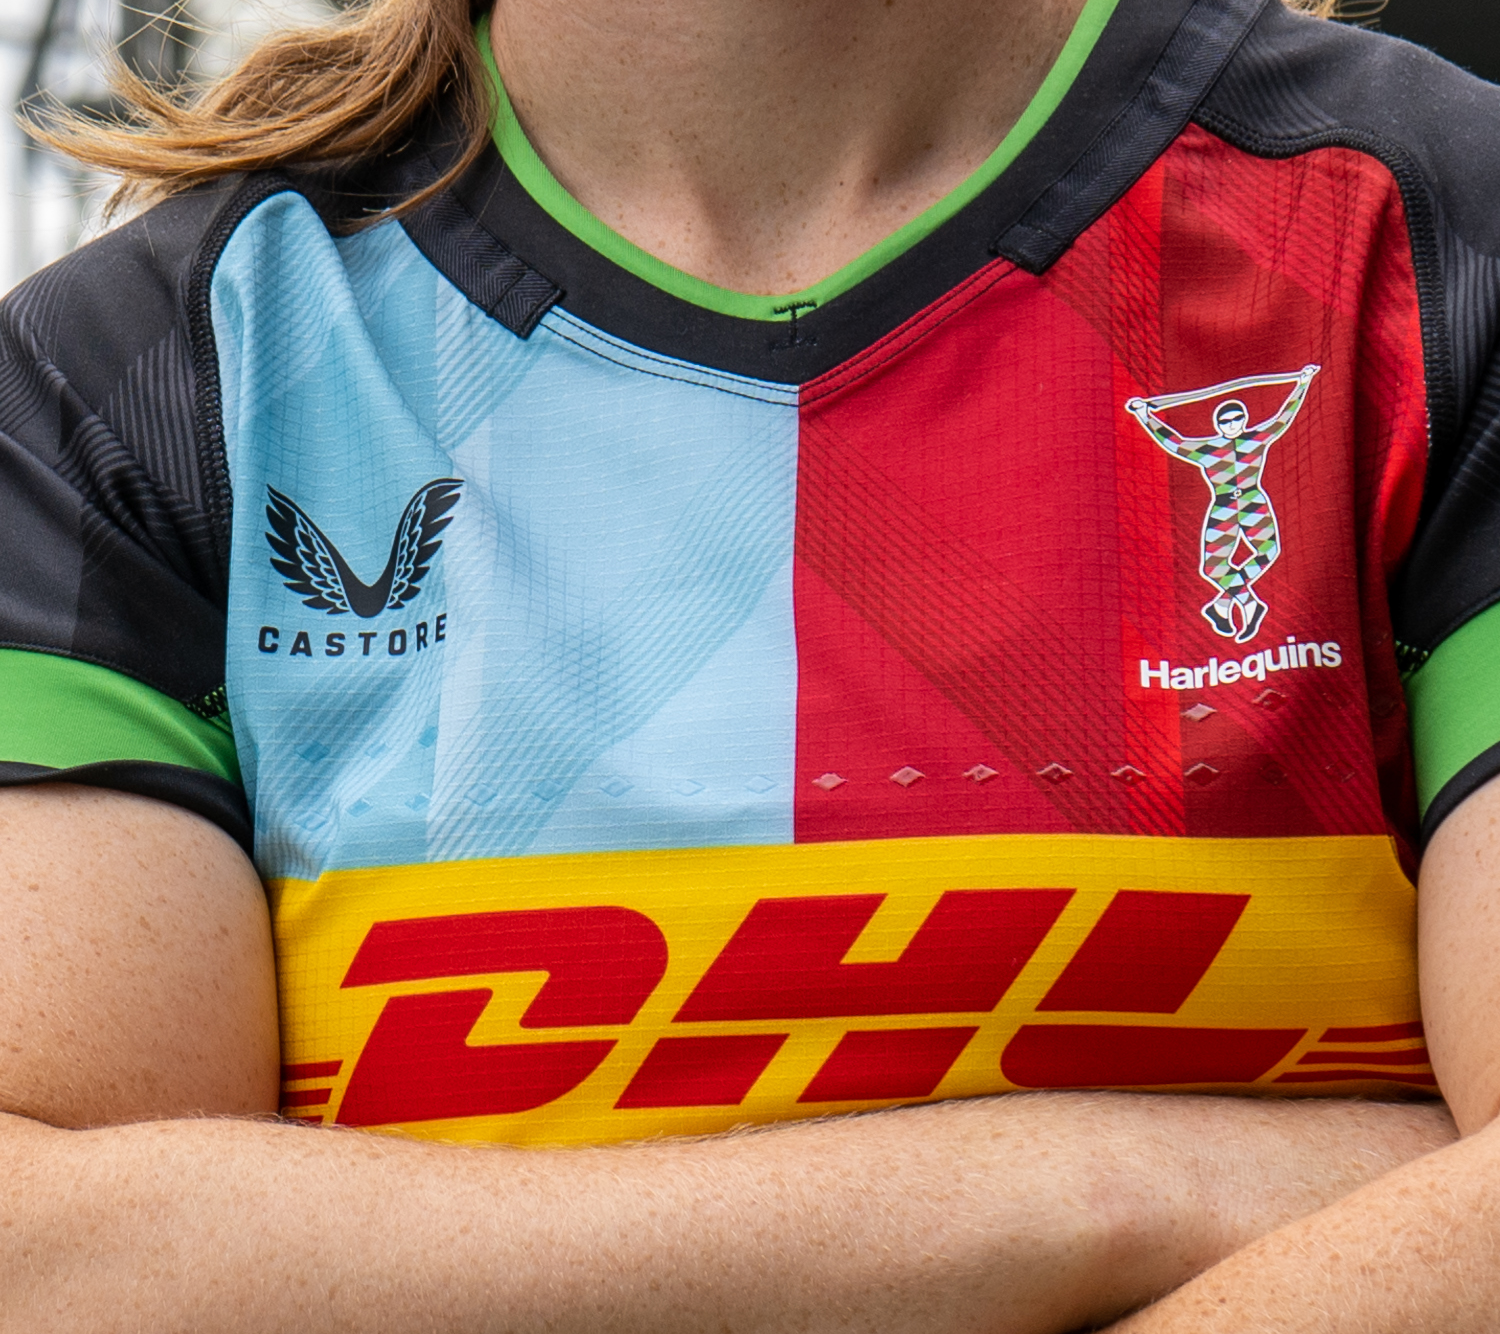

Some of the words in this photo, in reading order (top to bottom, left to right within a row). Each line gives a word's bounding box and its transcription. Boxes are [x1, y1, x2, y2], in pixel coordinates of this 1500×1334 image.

[258, 612, 449, 657] CASTORE
[1139, 636, 1342, 690] Harlequins
[334, 888, 1331, 1129] DHL
